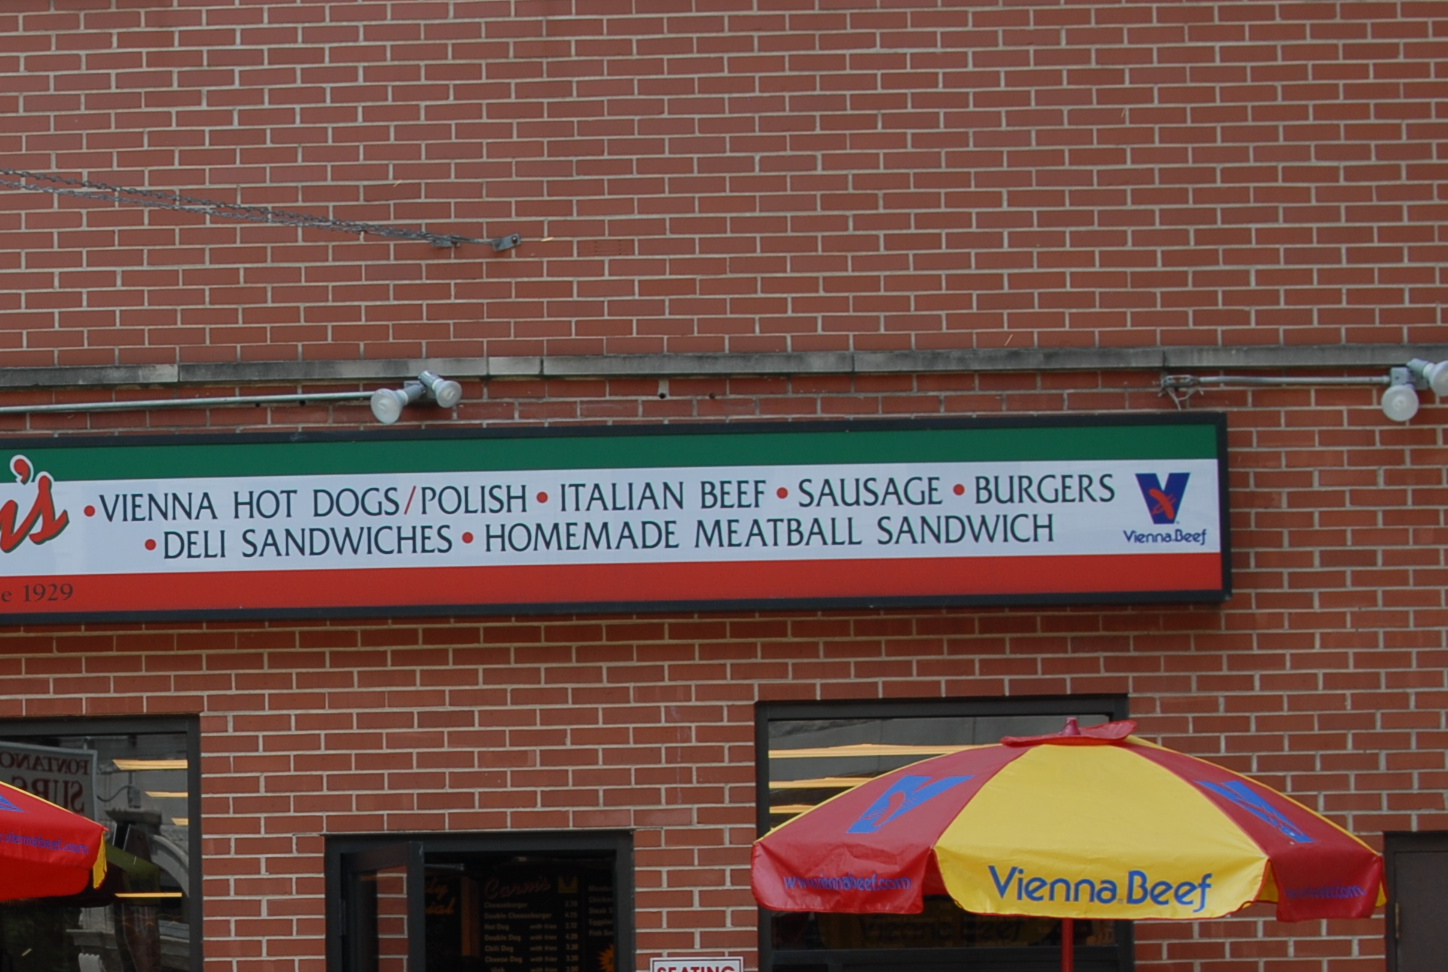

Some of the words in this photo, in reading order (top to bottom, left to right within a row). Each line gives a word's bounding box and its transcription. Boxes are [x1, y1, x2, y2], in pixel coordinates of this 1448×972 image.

[99, 491, 218, 522] VIENNA
[233, 489, 298, 519] HOT
[560, 481, 685, 511] ITALIAN
[701, 480, 766, 509] BEEF
[798, 476, 943, 508] SAUSAGE
[975, 474, 1115, 504] BURGERS
[163, 530, 226, 559] DELI
[242, 524, 453, 558] SANDWICHES
[485, 520, 679, 552] HOMEMADE
[694, 517, 862, 548] MEATBALL
[877, 513, 1054, 545] SANDWICH
[1123, 530, 1172, 544] Vienna
[1174, 528, 1207, 546] Beef
[24, 583, 74, 602] 1929
[987, 865, 1118, 904] Vienna
[1126, 869, 1213, 913] Beef
